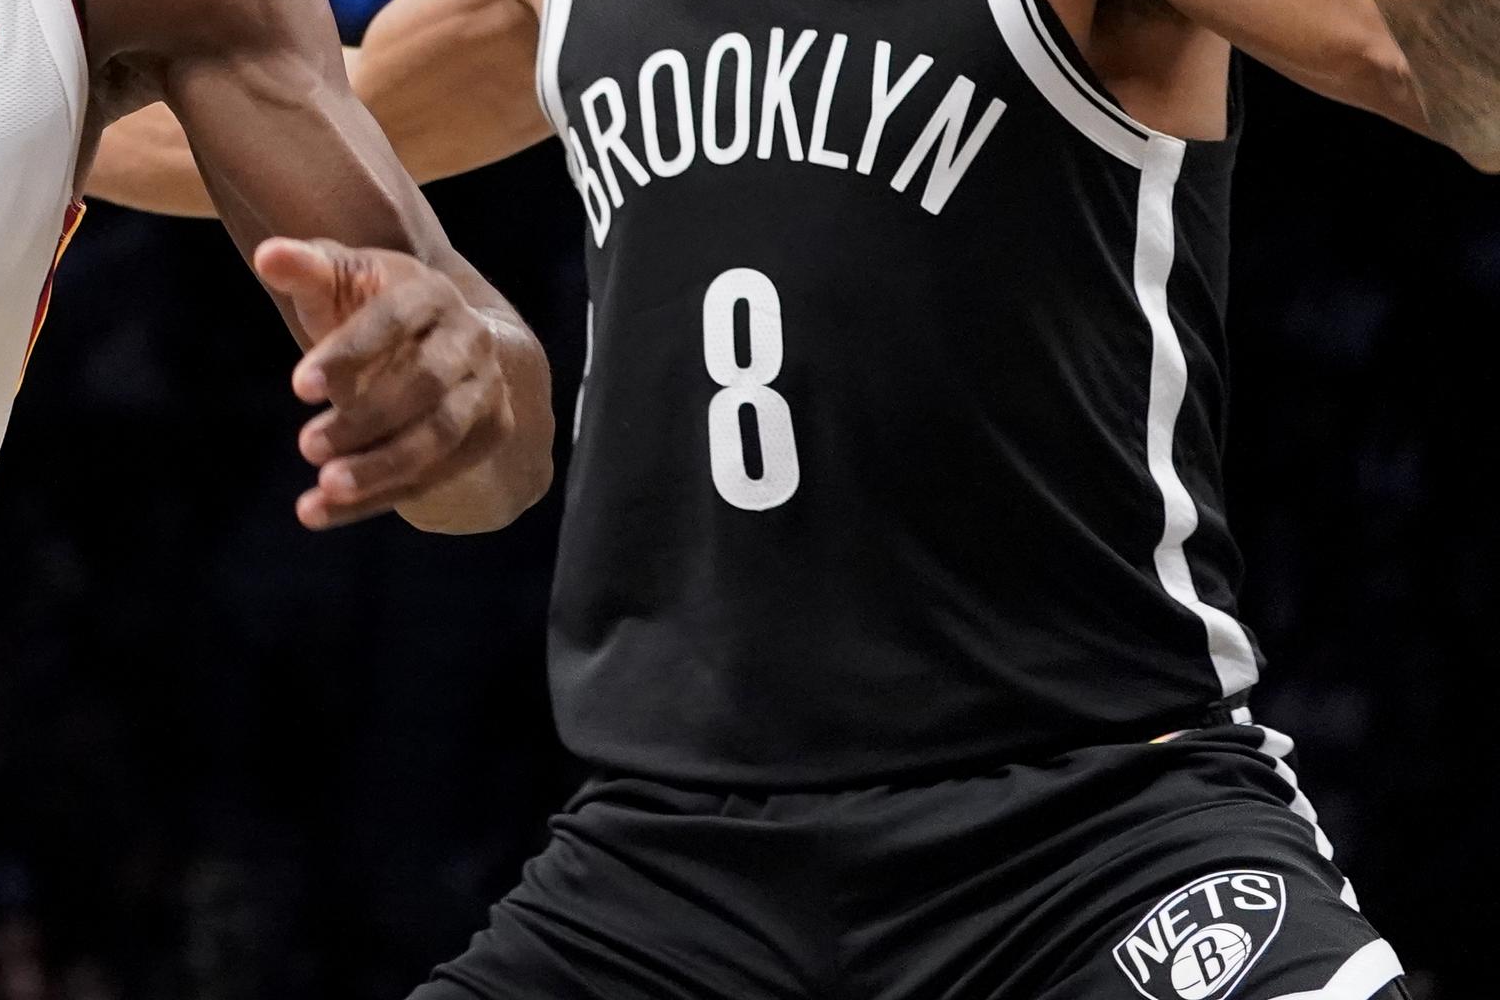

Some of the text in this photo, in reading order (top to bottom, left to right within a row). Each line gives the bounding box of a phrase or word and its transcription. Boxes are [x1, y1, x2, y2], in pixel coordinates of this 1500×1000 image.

[567, 27, 1007, 248] BROOKLYN
[703, 268, 800, 511] 8
[1126, 874, 1278, 984] NETS
[1192, 935, 1226, 987] B
